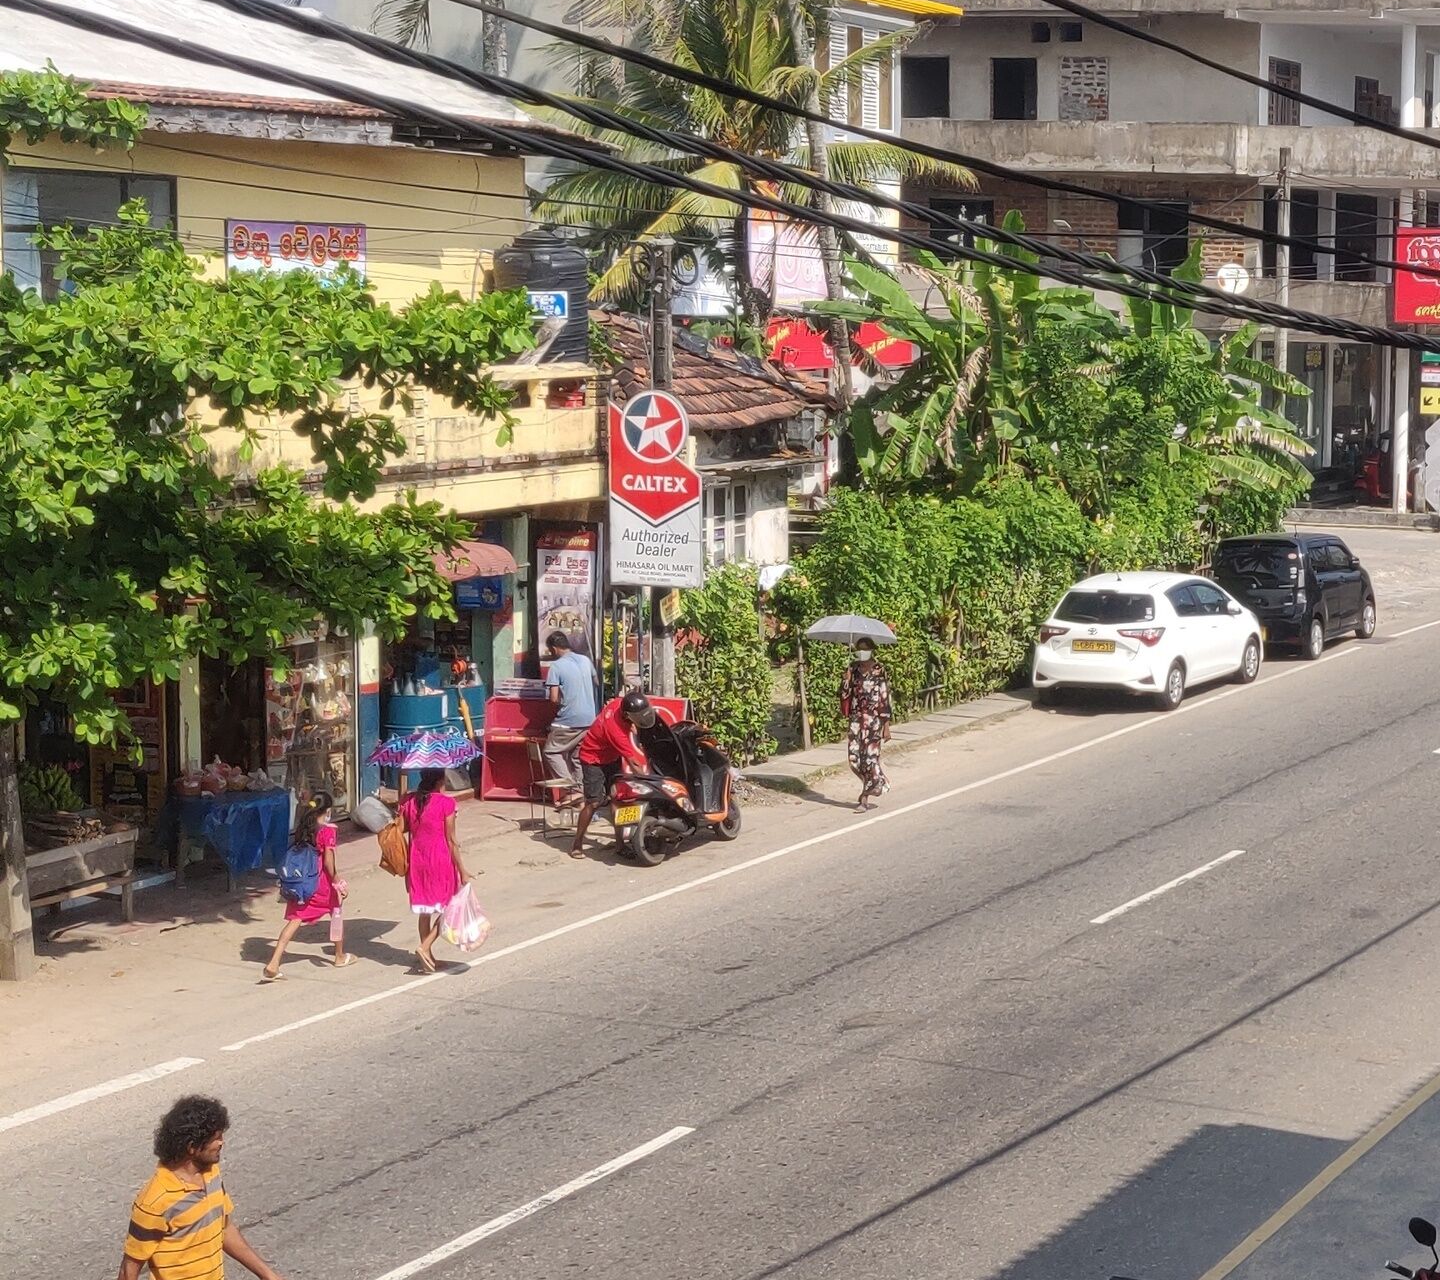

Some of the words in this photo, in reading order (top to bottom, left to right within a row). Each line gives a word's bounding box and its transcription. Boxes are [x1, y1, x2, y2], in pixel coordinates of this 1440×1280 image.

[621, 474, 688, 493] CALTEX
[622, 528, 689, 545] Authorized
[636, 542, 676, 558] Dealer
[616, 560, 656, 571] HIMASARA
[657, 562, 670, 572] OIL
[672, 563, 694, 574] MART
